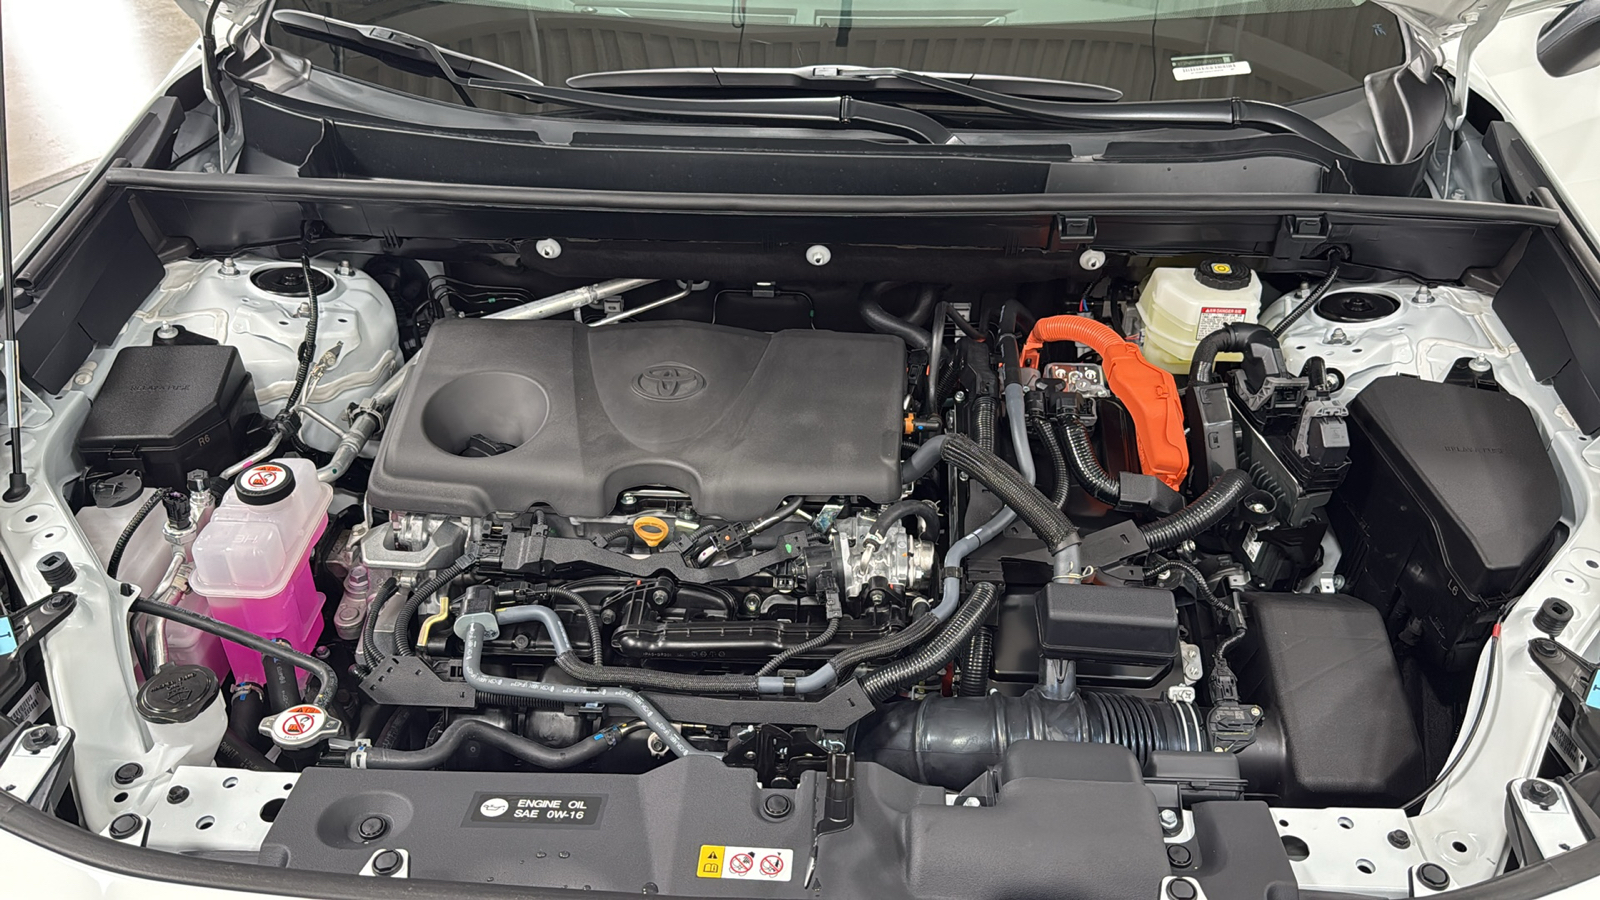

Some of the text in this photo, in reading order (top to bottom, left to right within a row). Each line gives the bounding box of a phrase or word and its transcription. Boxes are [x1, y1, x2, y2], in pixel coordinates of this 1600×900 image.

[198, 434, 211, 447] R6
[517, 799, 587, 809] ENGINE OIL
[513, 809, 585, 820] SAE 0W-16
